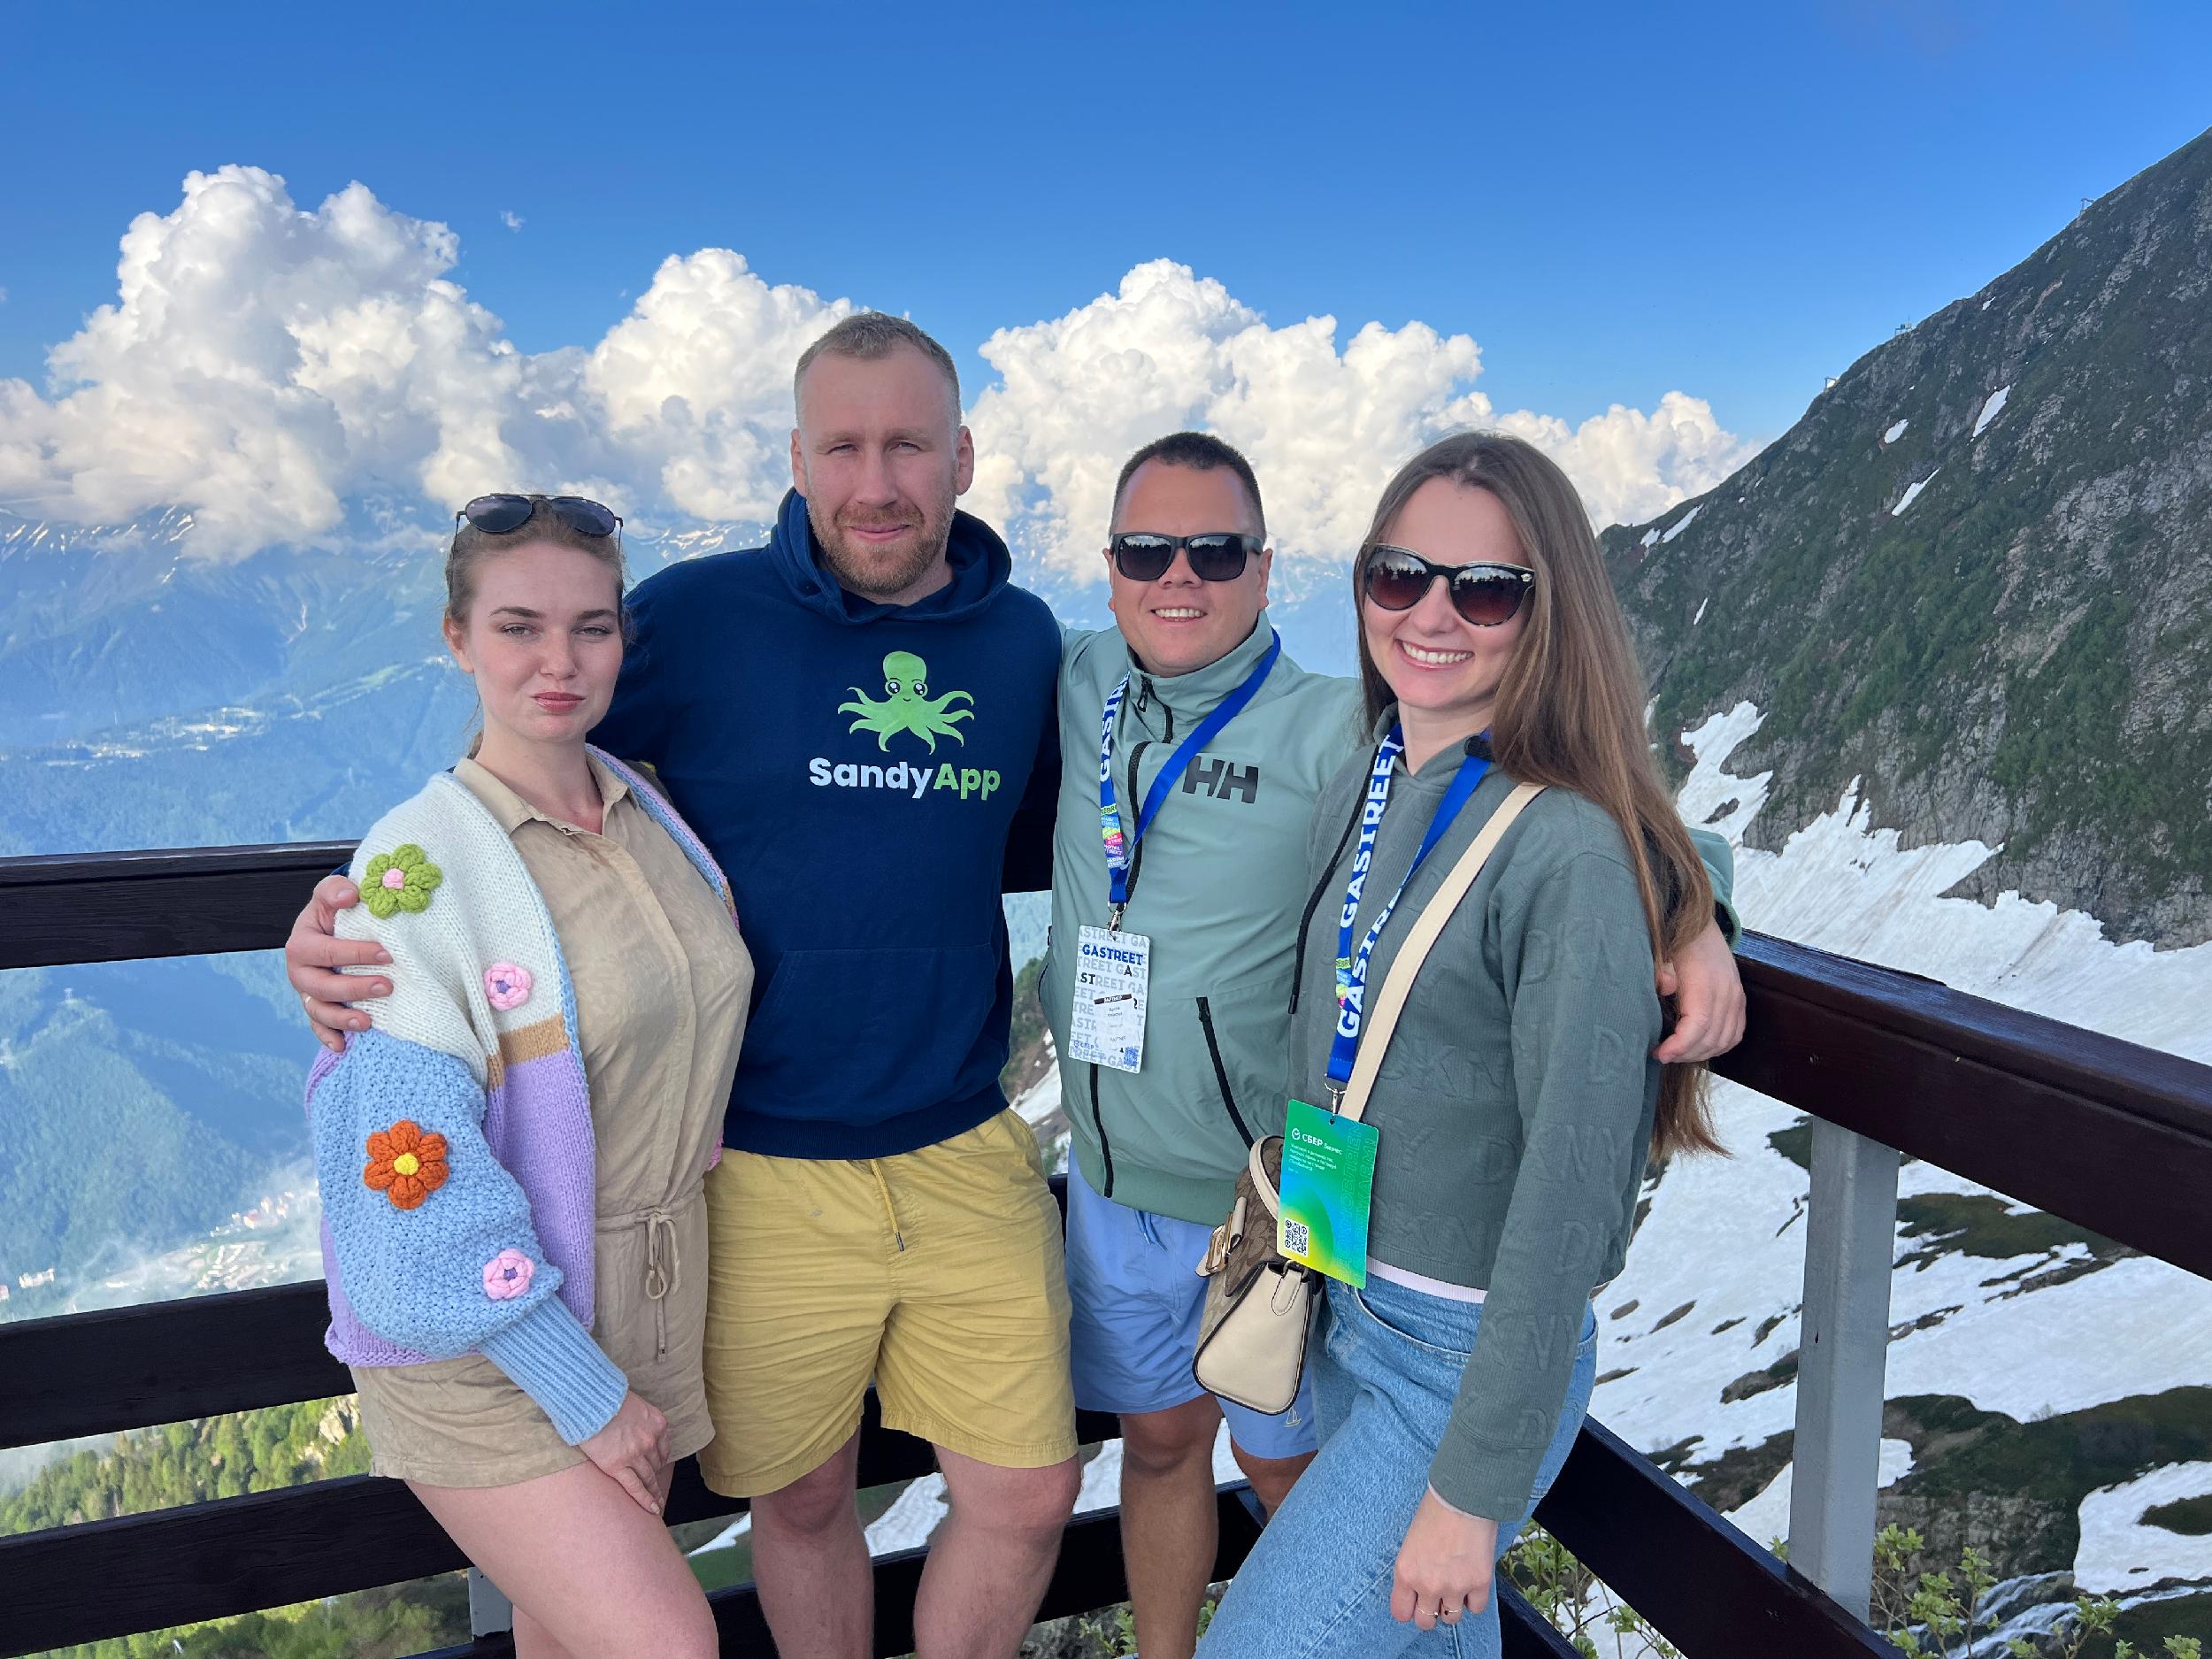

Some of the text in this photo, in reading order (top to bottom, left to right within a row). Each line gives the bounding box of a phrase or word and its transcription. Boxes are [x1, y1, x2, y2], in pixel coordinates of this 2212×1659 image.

[809, 757, 1001, 800] SandyApp
[1182, 756, 1259, 804] HH
[1340, 733, 1404, 929] GASTREET
[1131, 935, 1149, 949] GA
[1082, 943, 1143, 965] GASTREET
[1128, 981, 1147, 995] GA
[1302, 1133, 1324, 1147] СБЕР
